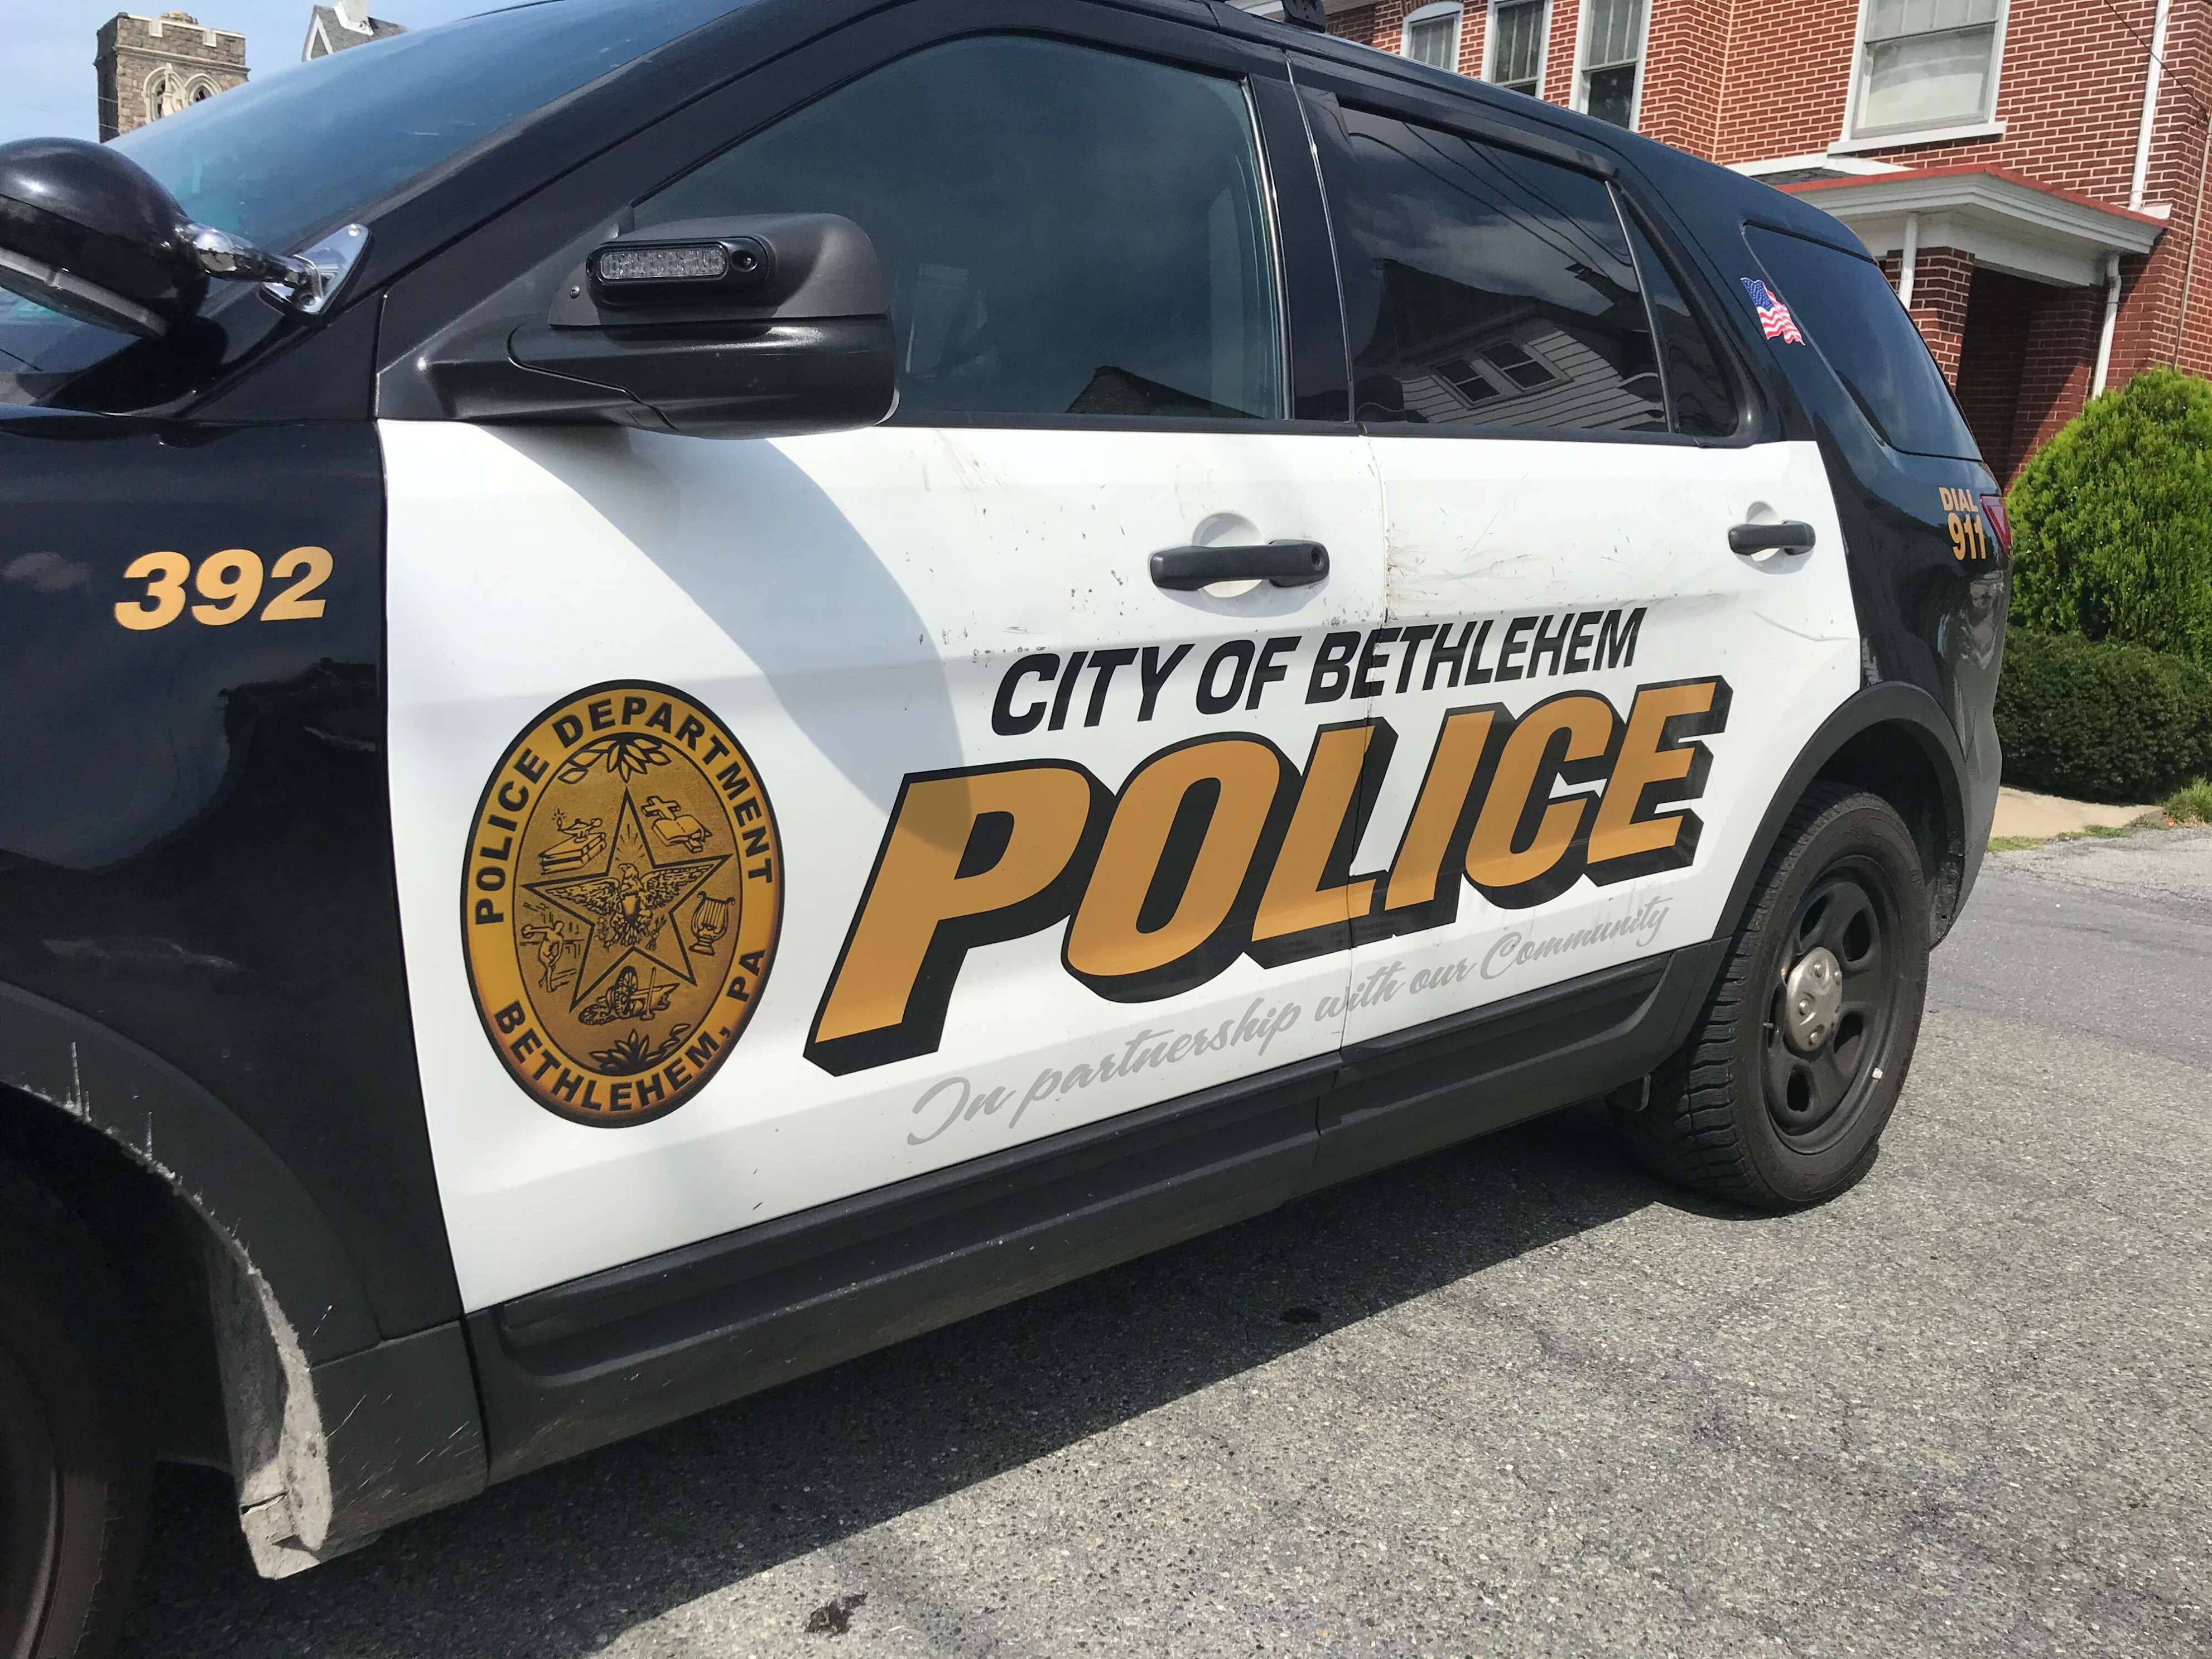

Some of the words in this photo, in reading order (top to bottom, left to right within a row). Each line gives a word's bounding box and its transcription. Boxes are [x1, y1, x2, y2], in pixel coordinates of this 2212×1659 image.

[1939, 487, 1978, 512] DIAL
[1948, 512, 1986, 561] 911
[114, 546, 334, 631] 392
[991, 643, 1195, 736] CITY
[1196, 635, 1302, 715] OF
[1305, 607, 1646, 705] BETHLEHEM
[475, 749, 550, 925] POLICE
[551, 696, 773, 884] DEPARTMENT
[804, 676, 1733, 1077] POLICE
[494, 1000, 732, 1111] BETHLEHEM,
[726, 948, 766, 1002] PA
[907, 1077, 1016, 1145] In
[1009, 997, 1301, 1129] partnership
[1314, 960, 1406, 1021] with
[1409, 958, 1477, 995] our
[1480, 895, 1674, 980] Community
